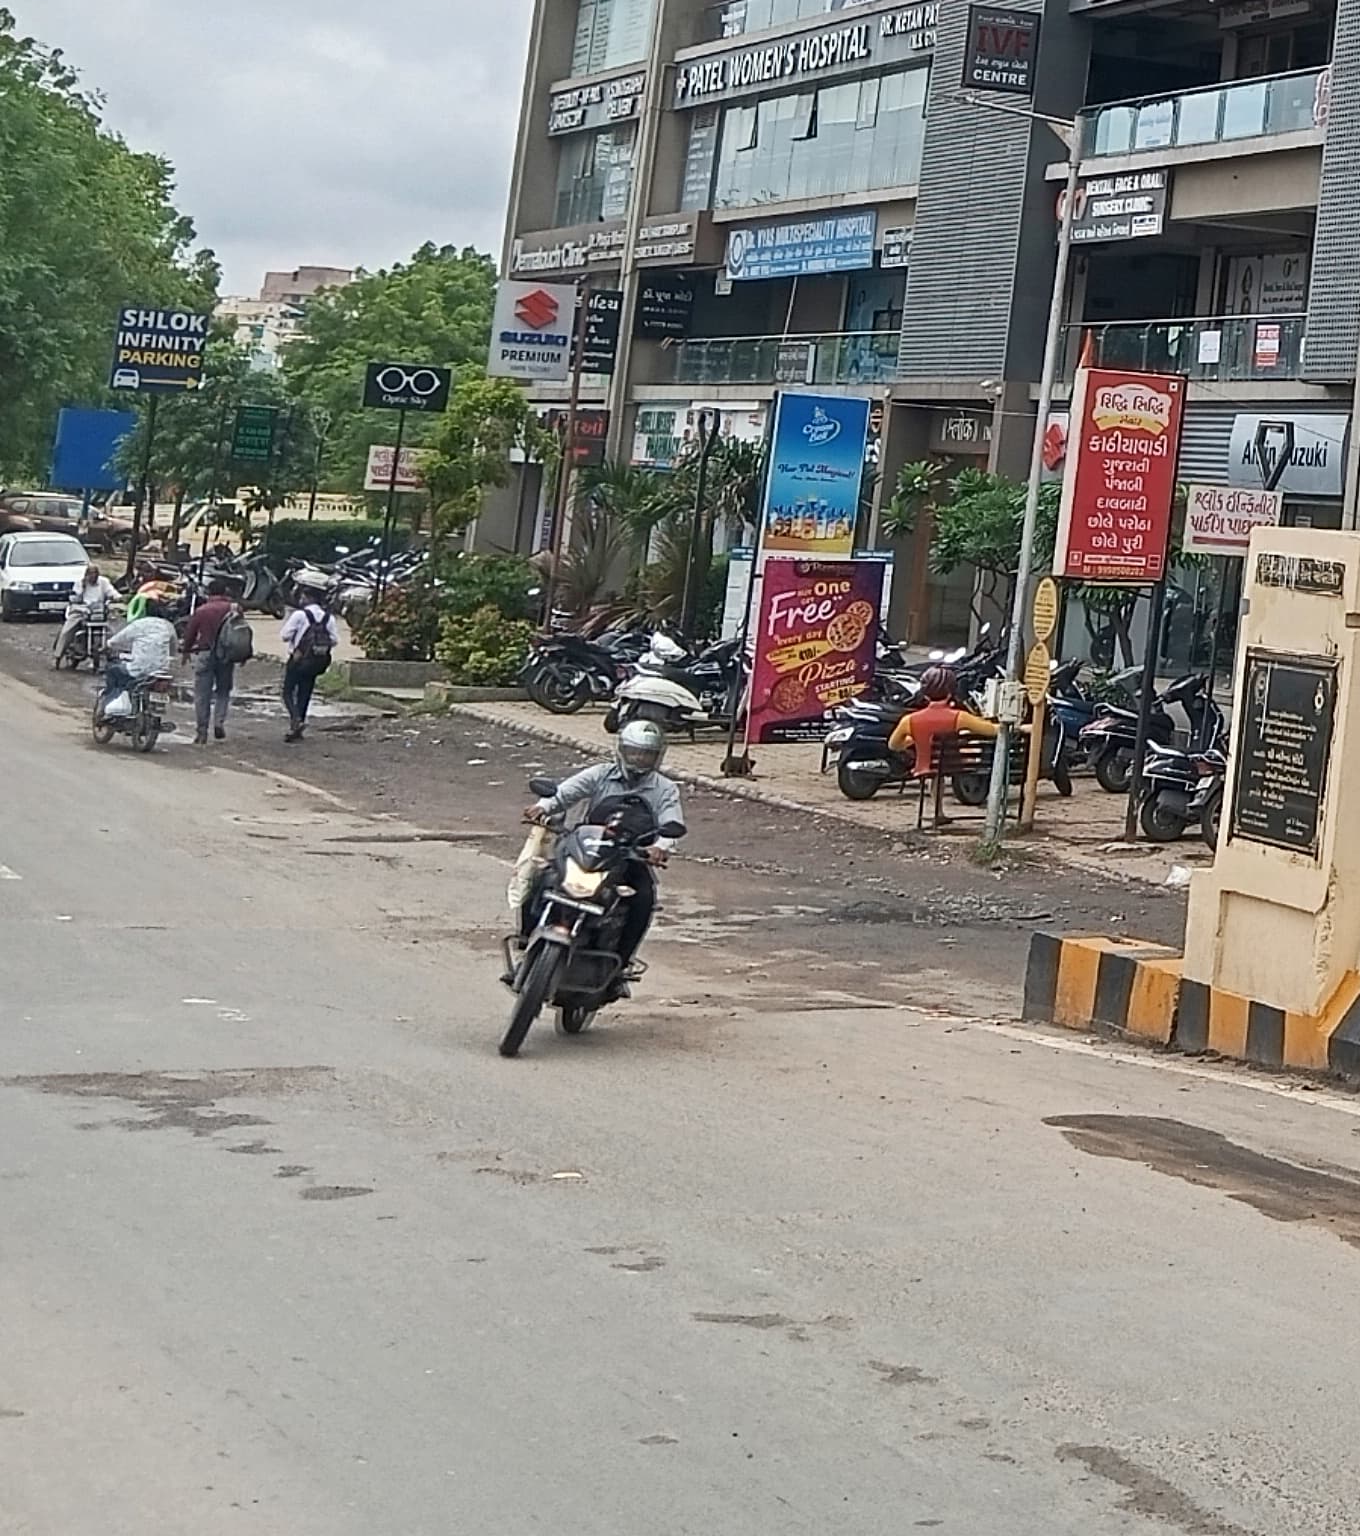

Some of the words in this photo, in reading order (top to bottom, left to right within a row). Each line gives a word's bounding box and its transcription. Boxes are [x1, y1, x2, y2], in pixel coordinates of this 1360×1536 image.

[688, 61, 727, 97] PATEL
[728, 42, 797, 88] WOMEN'S
[798, 24, 870, 72] HOSPITAL
[972, 68, 1028, 86] CENTRE
[122, 309, 207, 333] SHLOK
[117, 331, 206, 353] INFINITY
[499, 331, 568, 347] SUZUKI
[118, 349, 201, 369] PARKING
[500, 348, 562, 364] PREMIUM
[1088, 431, 1168, 457] કાઠીયાવાડી
[1102, 458, 1150, 475] ગુજરાતી
[1104, 476, 1143, 492] પંજાબી
[1096, 495, 1148, 512] દાલબાટી
[1087, 513, 1113, 530] છોલે
[1118, 515, 1151, 532] પરોઠા
[1091, 535, 1118, 550] છોલે
[1122, 535, 1143, 554] પુરી
[813, 580, 851, 596] One
[768, 591, 837, 636] Free
[798, 658, 856, 688] Pizza
